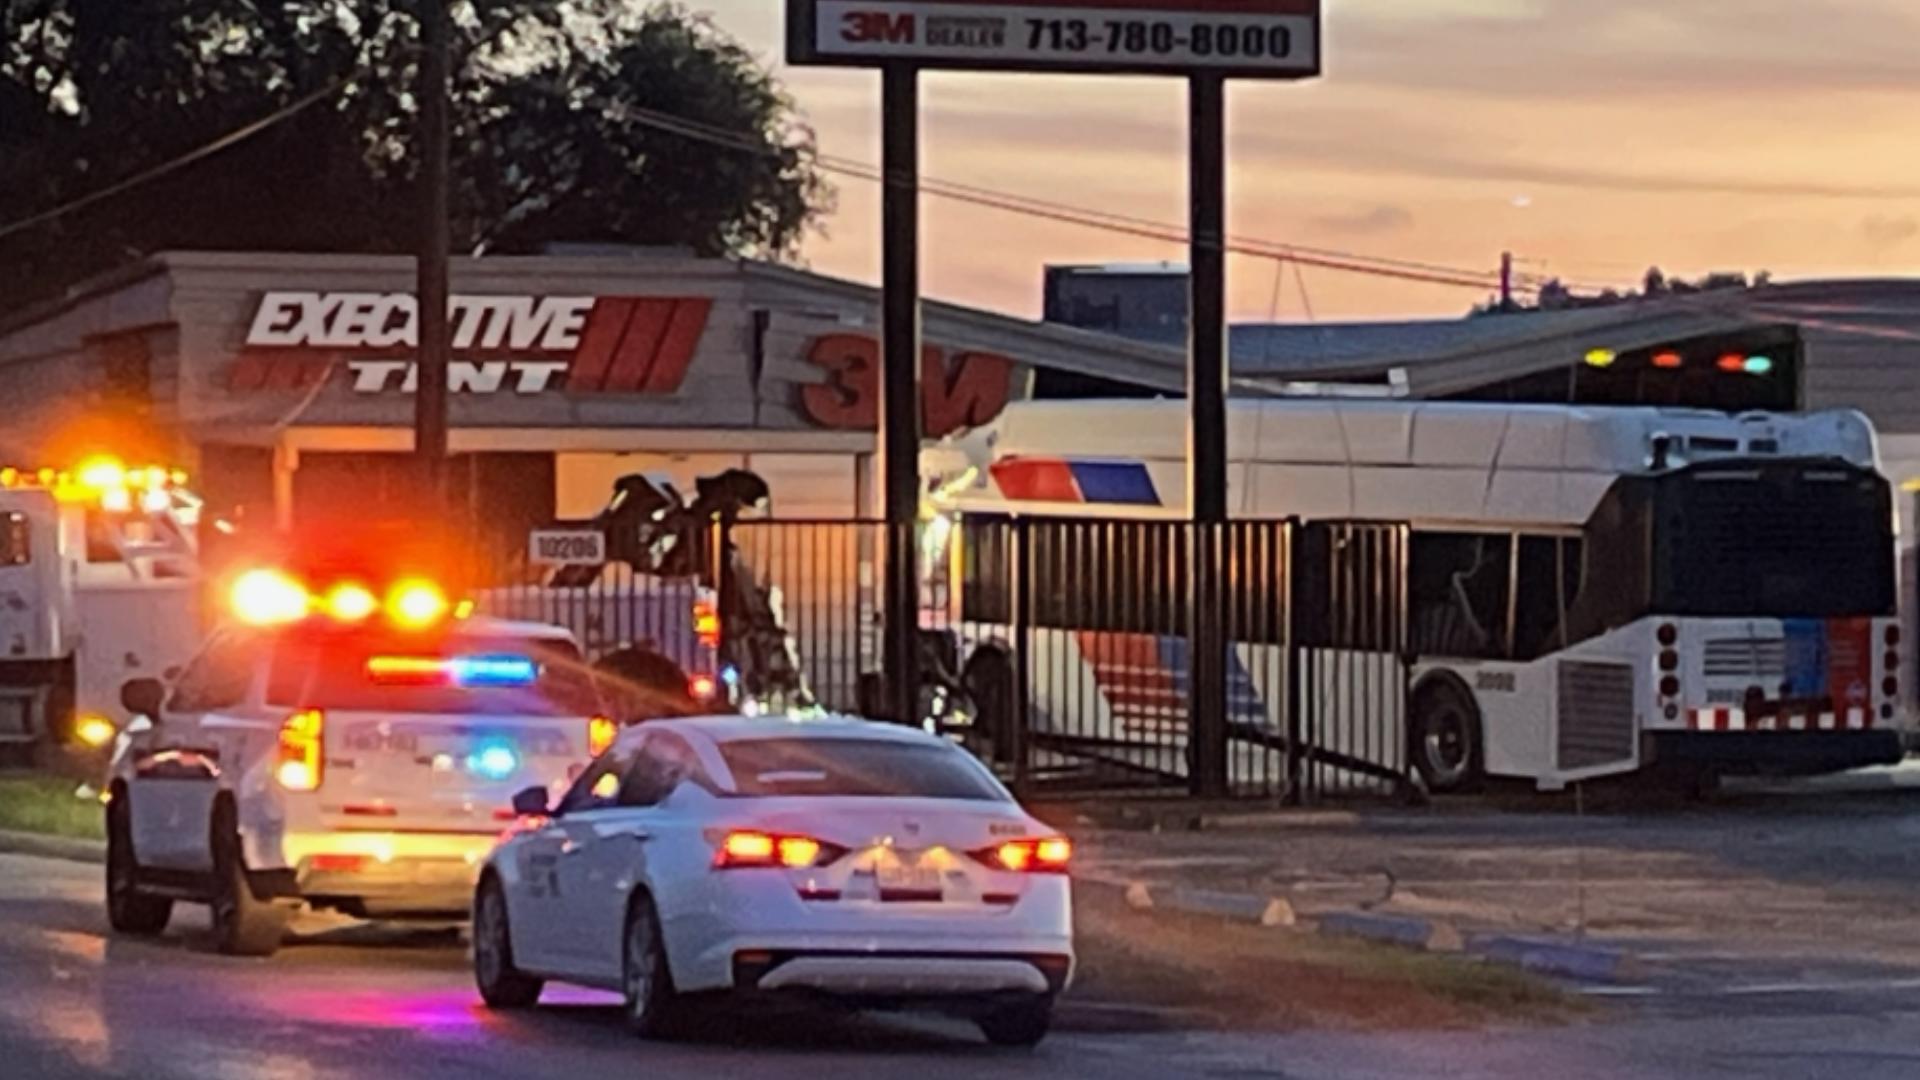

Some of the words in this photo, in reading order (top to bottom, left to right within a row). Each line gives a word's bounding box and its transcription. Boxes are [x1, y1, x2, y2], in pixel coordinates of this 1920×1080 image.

[840, 11, 916, 44] 3M
[1025, 18, 1291, 58] 713-780-8000
[247, 292, 596, 349] EXECTIVE
[803, 333, 1014, 440] 3M
